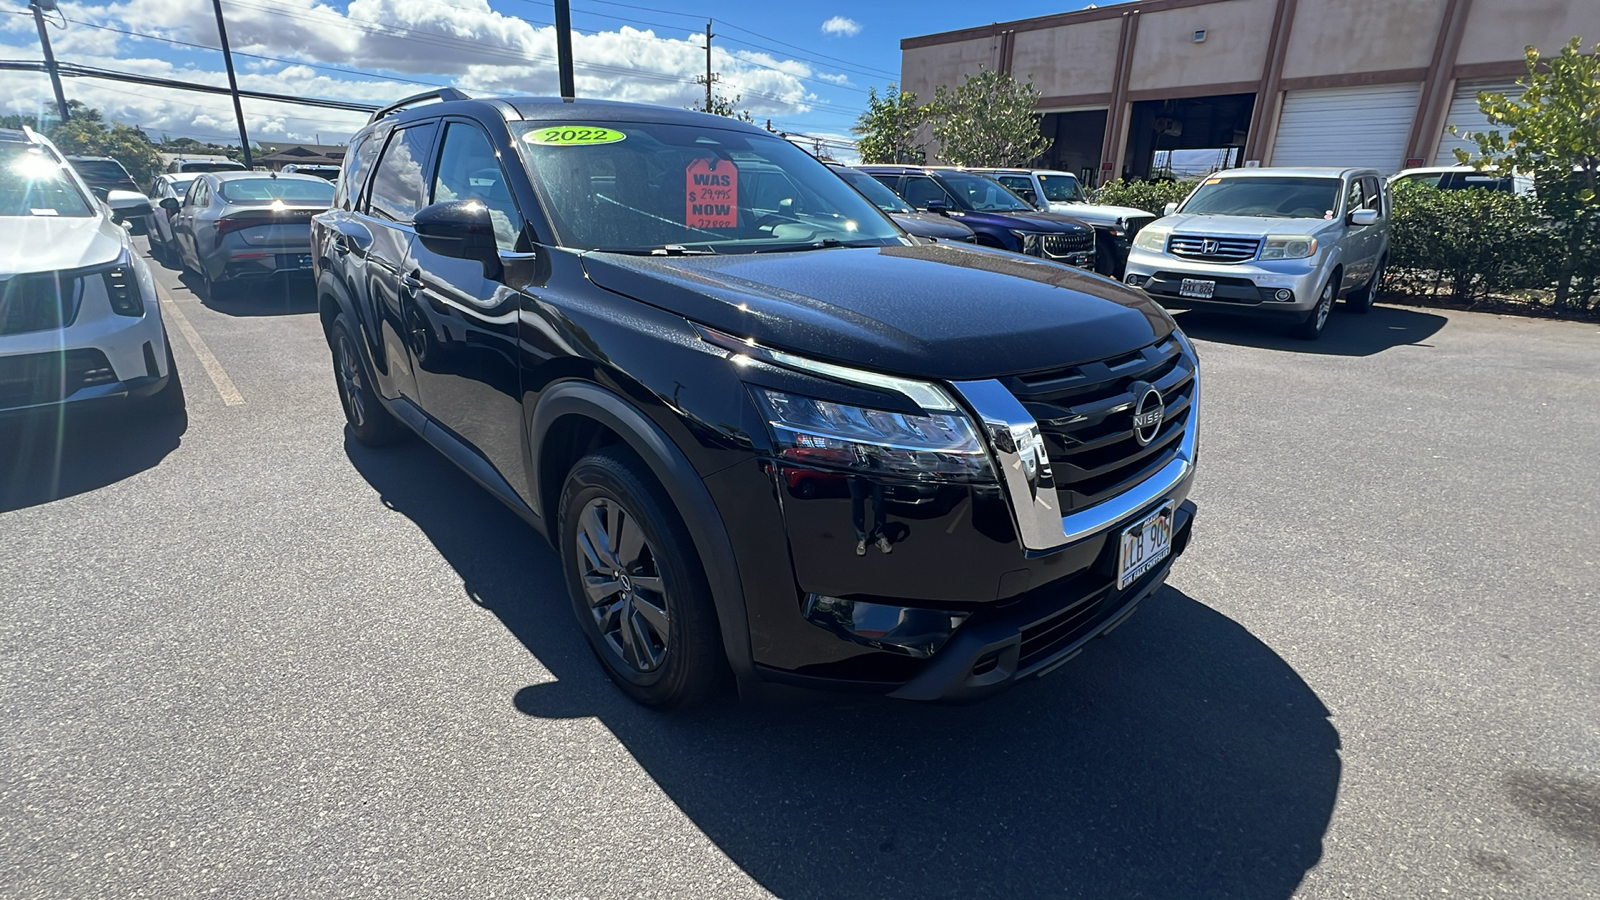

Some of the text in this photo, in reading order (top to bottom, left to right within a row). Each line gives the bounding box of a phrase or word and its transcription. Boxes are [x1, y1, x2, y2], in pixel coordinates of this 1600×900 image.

[545, 130, 608, 142] 2022
[693, 174, 731, 187] WAS
[689, 191, 697, 202] $
[692, 204, 731, 216] NOW
